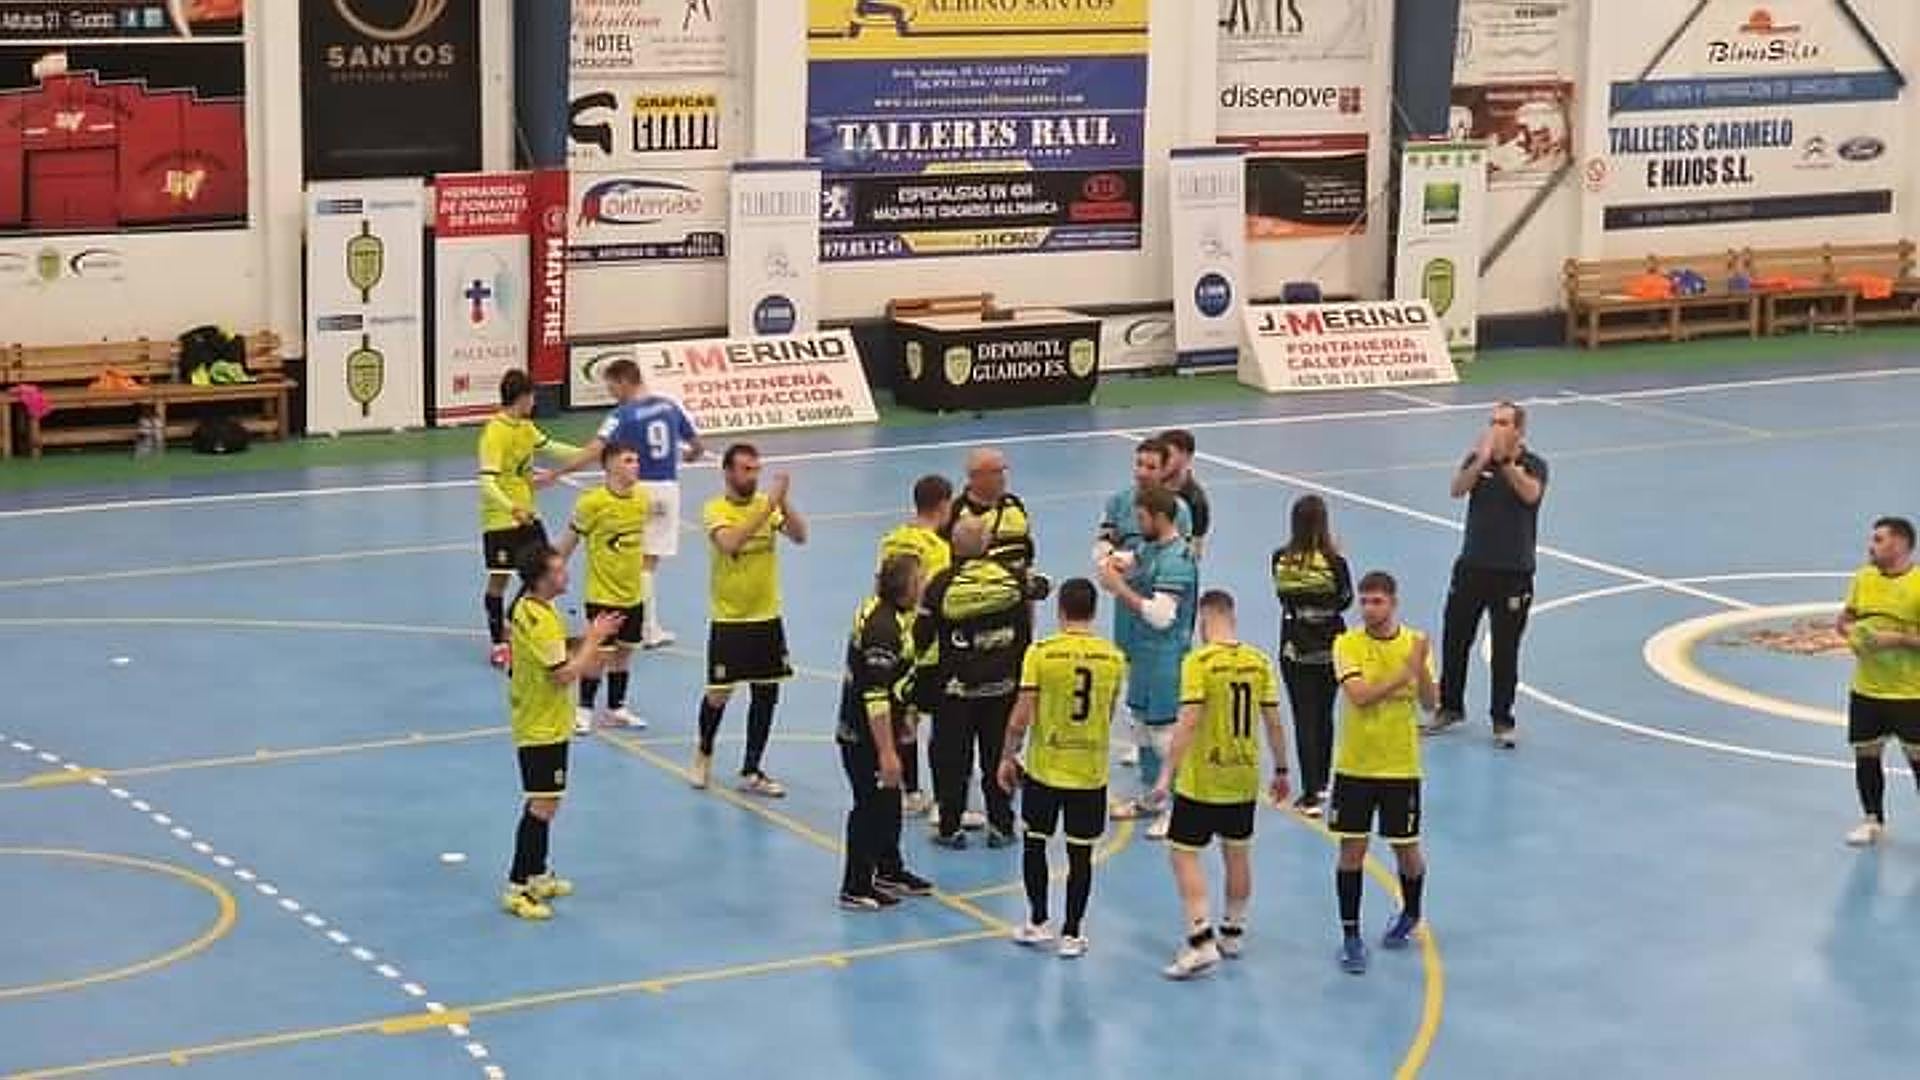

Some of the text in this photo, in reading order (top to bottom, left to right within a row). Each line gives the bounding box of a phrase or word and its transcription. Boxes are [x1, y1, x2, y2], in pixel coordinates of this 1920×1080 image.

[327, 43, 456, 67] SANTOS
[584, 34, 633, 52] HOTEL
[635, 95, 718, 108] GRAFICAS
[1220, 84, 1337, 109] disenove
[837, 116, 1115, 151] TALLERES RAUL
[1608, 118, 1793, 155] TALLERES CARMELO
[1647, 157, 1753, 187] E HIJOS S.L.
[441, 186, 526, 200] HERMANDAD
[898, 184, 987, 202] ESPECIALISTAS
[990, 184, 1008, 198] EN
[440, 199, 528, 214] DE DONANTES
[450, 213, 518, 226] DE SANGRE
[544, 239, 564, 344] MAPFRE
[1258, 306, 1428, 335] J.MERINO
[654, 338, 846, 371] J.MERINO
[978, 340, 1064, 360] DEPORCYL
[973, 364, 1041, 382] GUARDO
[796, 405, 853, 422] GUARDO
[647, 420, 671, 460] 9
[1071, 667, 1093, 721] 3
[1229, 681, 1252, 738] 11
